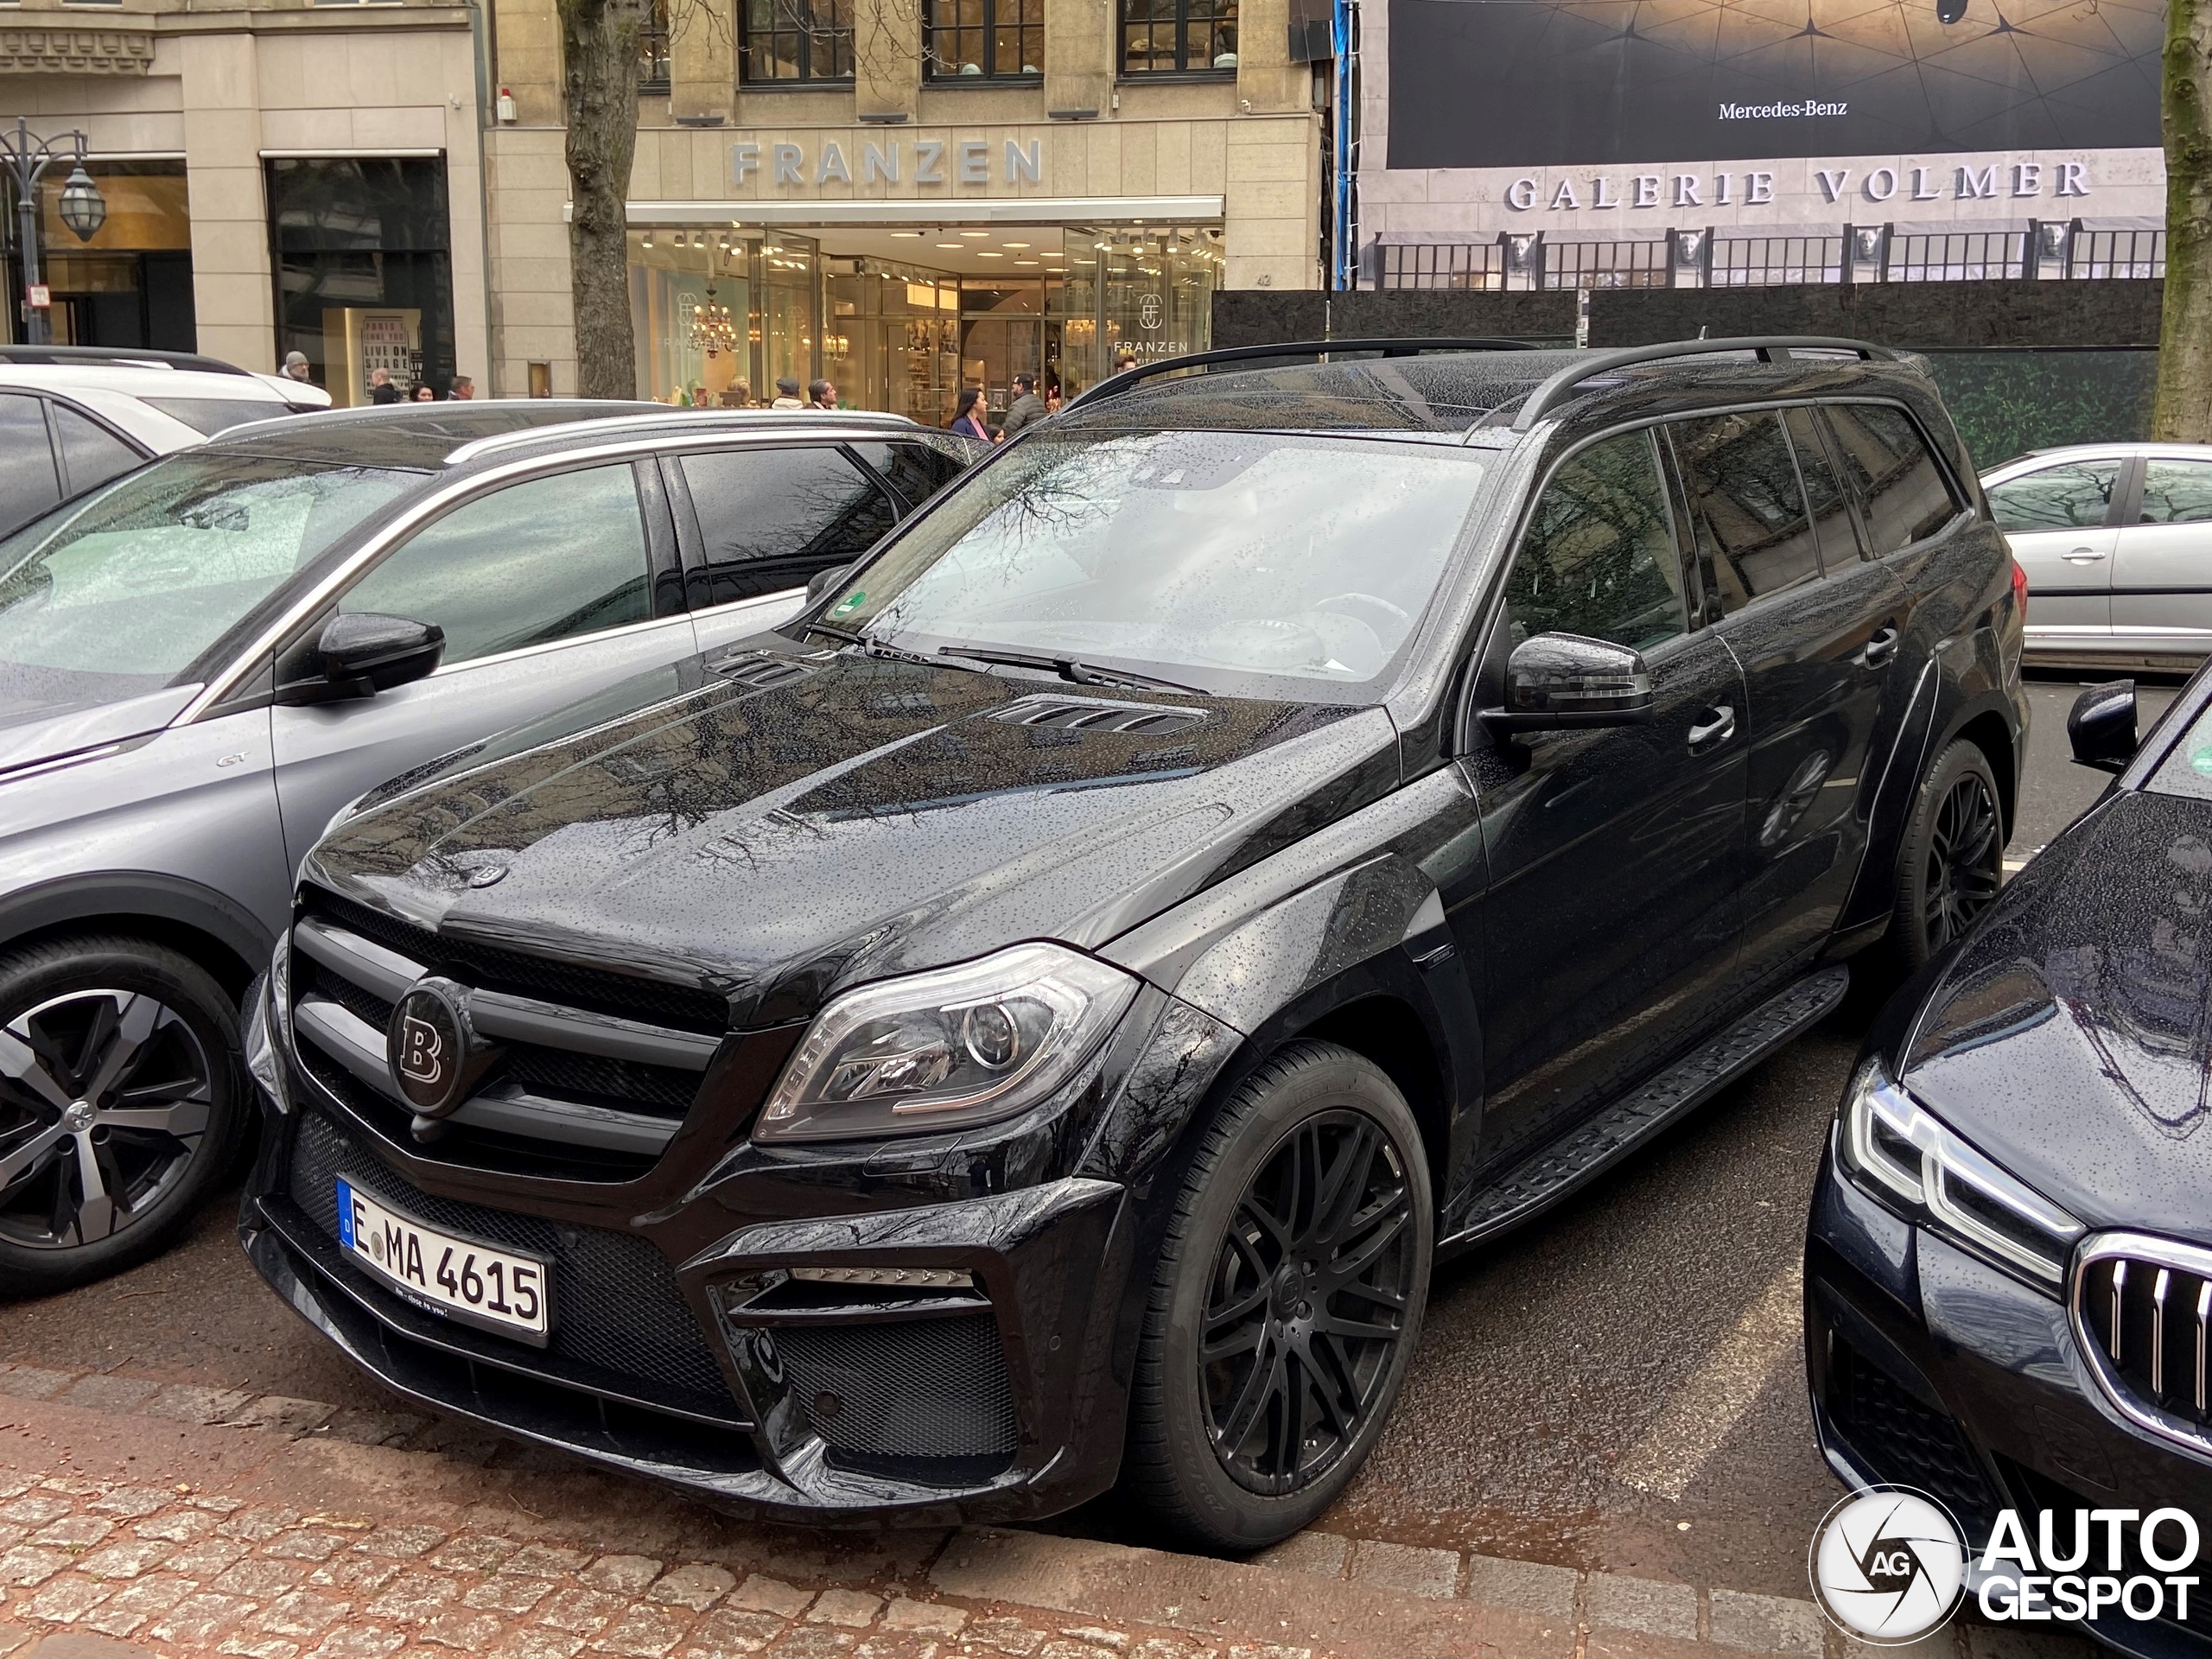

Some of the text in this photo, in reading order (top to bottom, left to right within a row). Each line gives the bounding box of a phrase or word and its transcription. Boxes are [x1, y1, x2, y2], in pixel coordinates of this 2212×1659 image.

[1718, 101, 1848, 121] Mercedes-Benz
[732, 139, 1042, 185] FRANZEN
[1508, 162, 2094, 212] GALERIE VOLMER
[365, 346, 388, 357] LIVE
[393, 346, 407, 357] ON
[1114, 341, 1188, 353] FRANZEN
[365, 358, 408, 369] STAGE
[475, 866, 499, 880] B
[400, 1016, 442, 1084] B
[345, 1219, 350, 1233] D
[353, 1198, 538, 1319] E MA 4615
